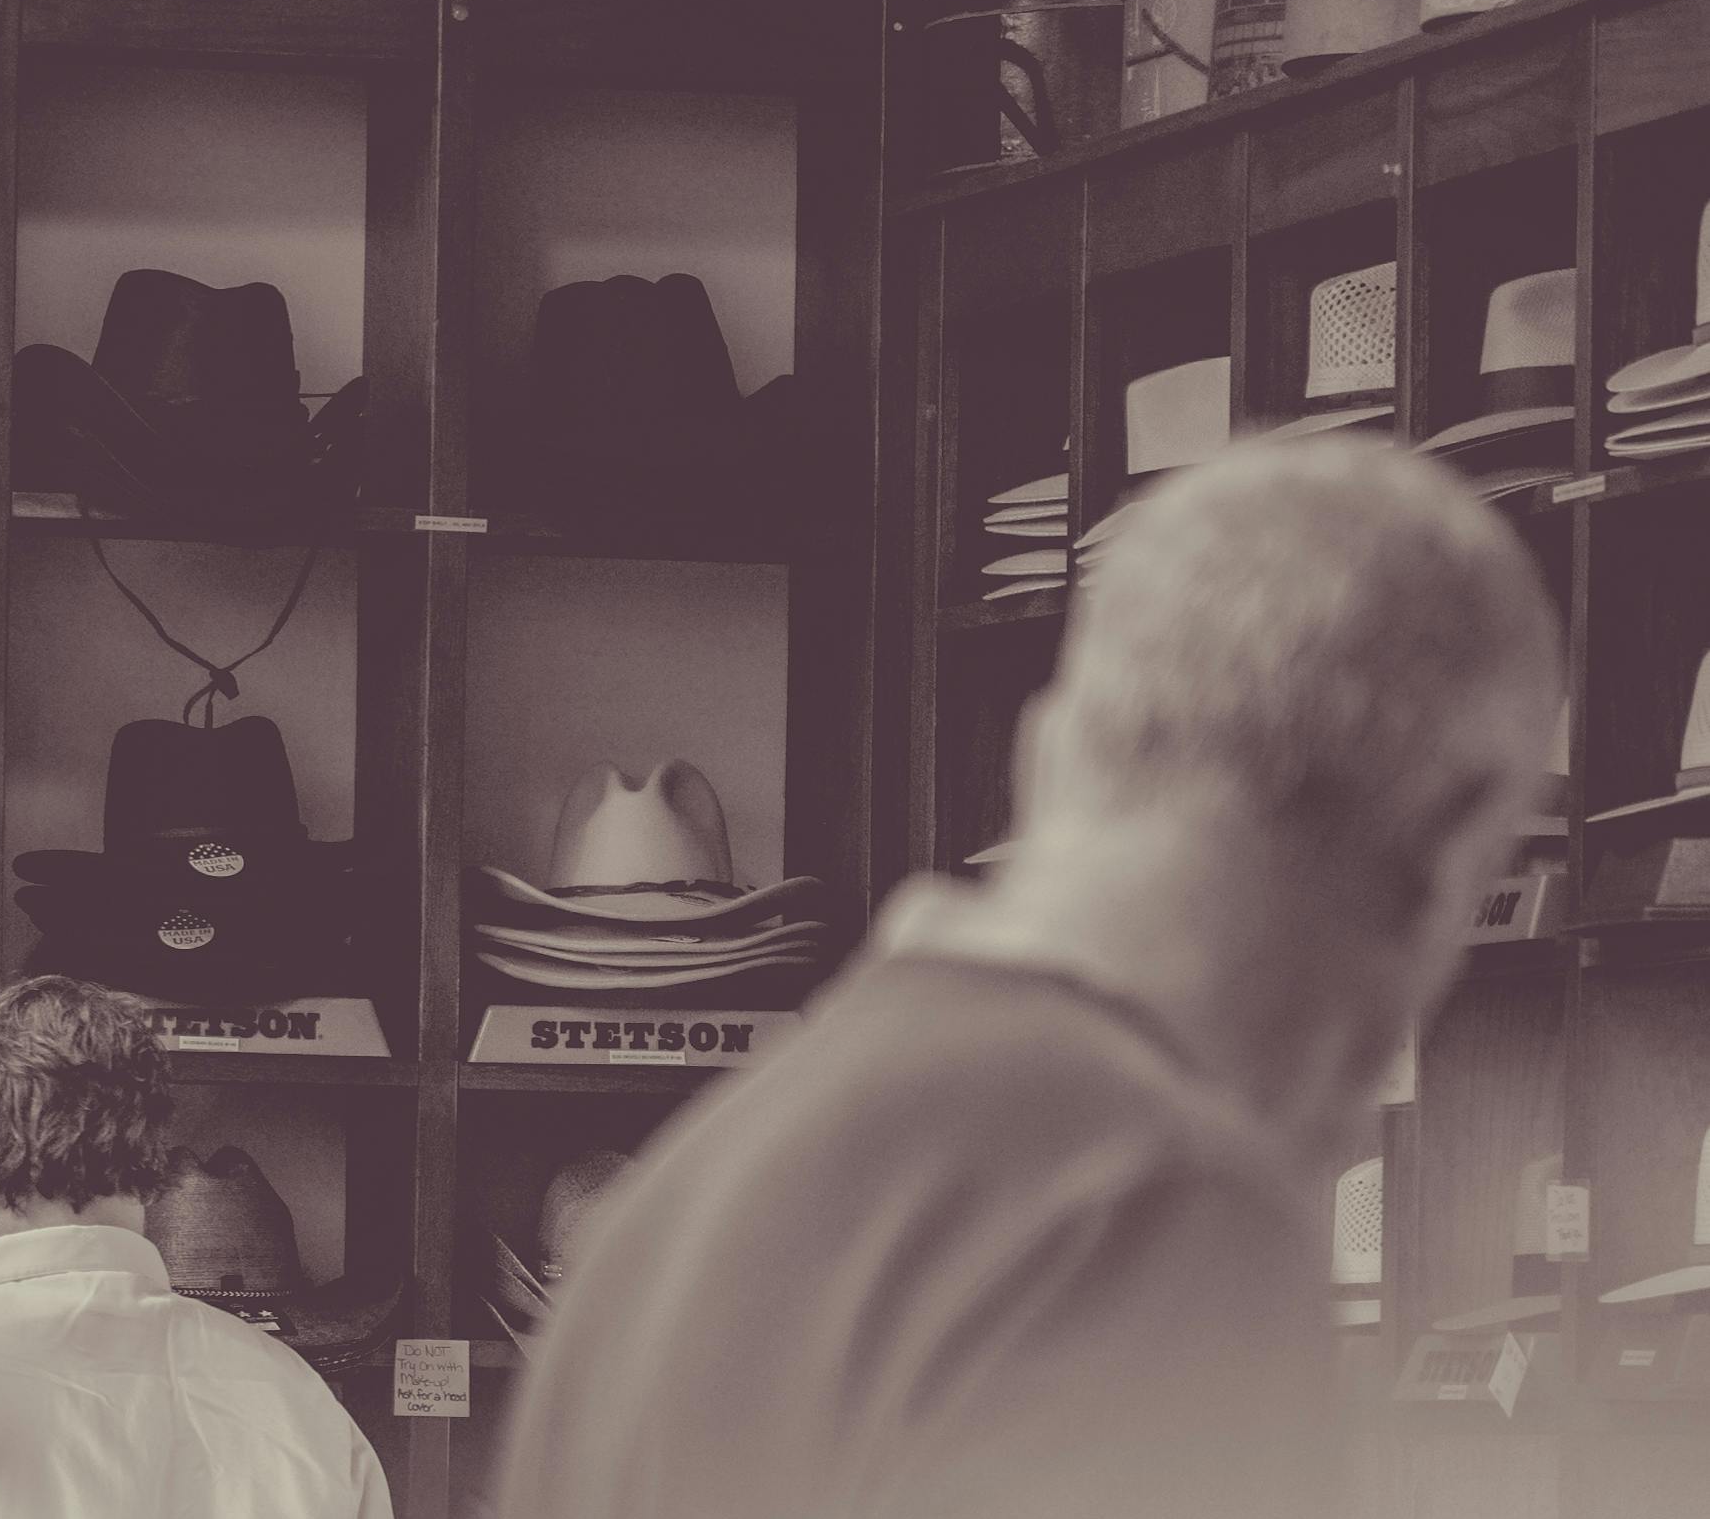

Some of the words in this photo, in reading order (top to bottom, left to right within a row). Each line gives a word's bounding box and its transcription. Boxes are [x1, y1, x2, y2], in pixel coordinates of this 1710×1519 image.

[204, 863, 236, 873] USA
[173, 936, 204, 945] USA
[143, 1008, 321, 1040] TETSON
[531, 1020, 754, 1052] STETSON
[403, 1344, 421, 1356] Do
[425, 1345, 451, 1357] NOT
[397, 1358, 416, 1377] Try
